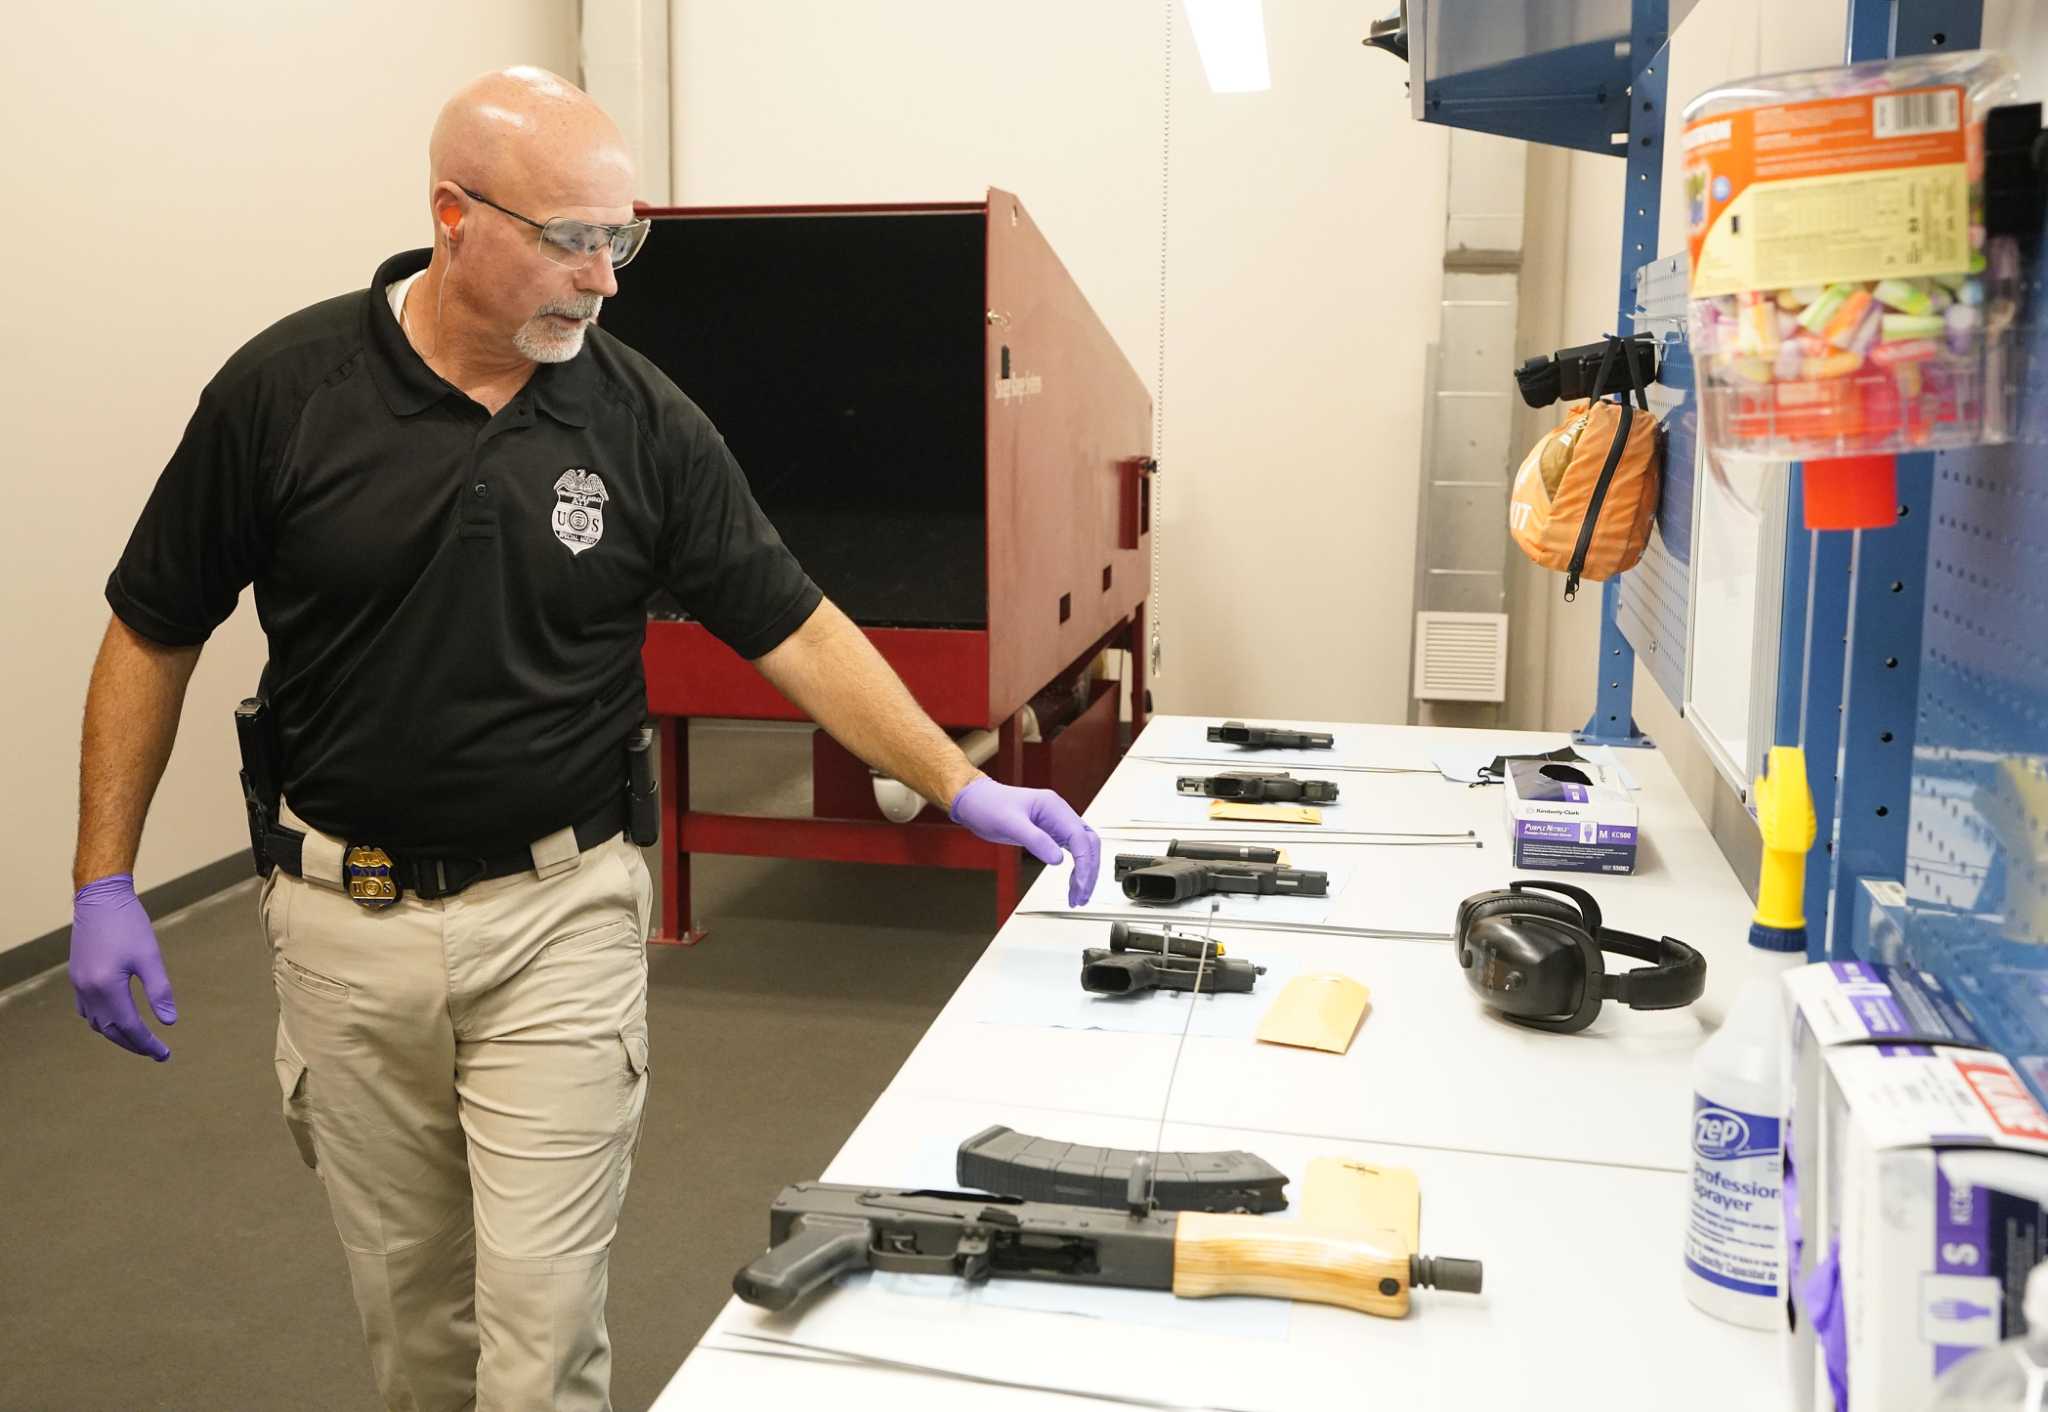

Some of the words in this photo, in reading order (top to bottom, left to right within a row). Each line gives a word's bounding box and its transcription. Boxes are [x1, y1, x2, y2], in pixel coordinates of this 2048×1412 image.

[557, 511, 566, 526] U
[591, 518, 599, 532] S
[1599, 830, 1608, 839] M
[1942, 1242, 1980, 1267] S
